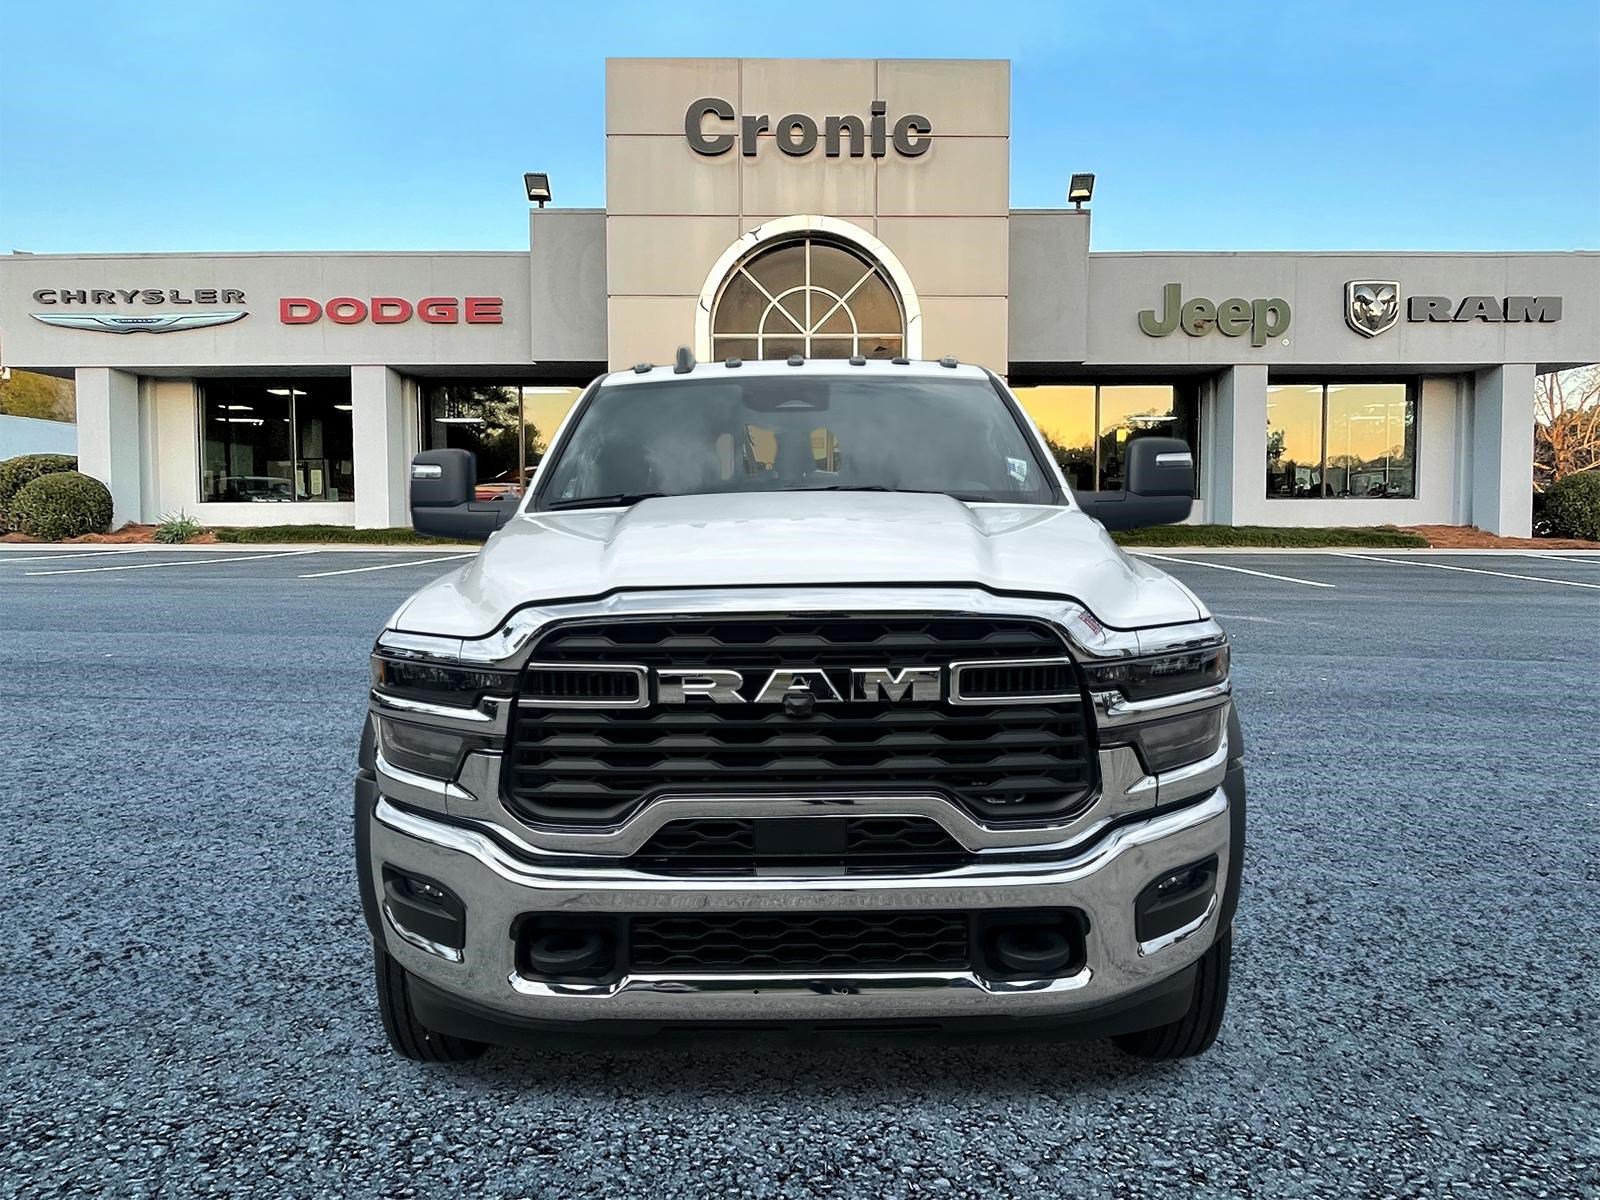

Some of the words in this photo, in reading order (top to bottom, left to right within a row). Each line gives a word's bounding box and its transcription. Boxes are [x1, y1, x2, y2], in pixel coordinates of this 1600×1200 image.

[685, 97, 932, 158] Cronic
[32, 288, 246, 305] CHRYSLER
[280, 297, 504, 325] DODGE
[1407, 295, 1562, 323] RAM
[1138, 282, 1291, 347] Jeep
[656, 667, 942, 704] RAM
